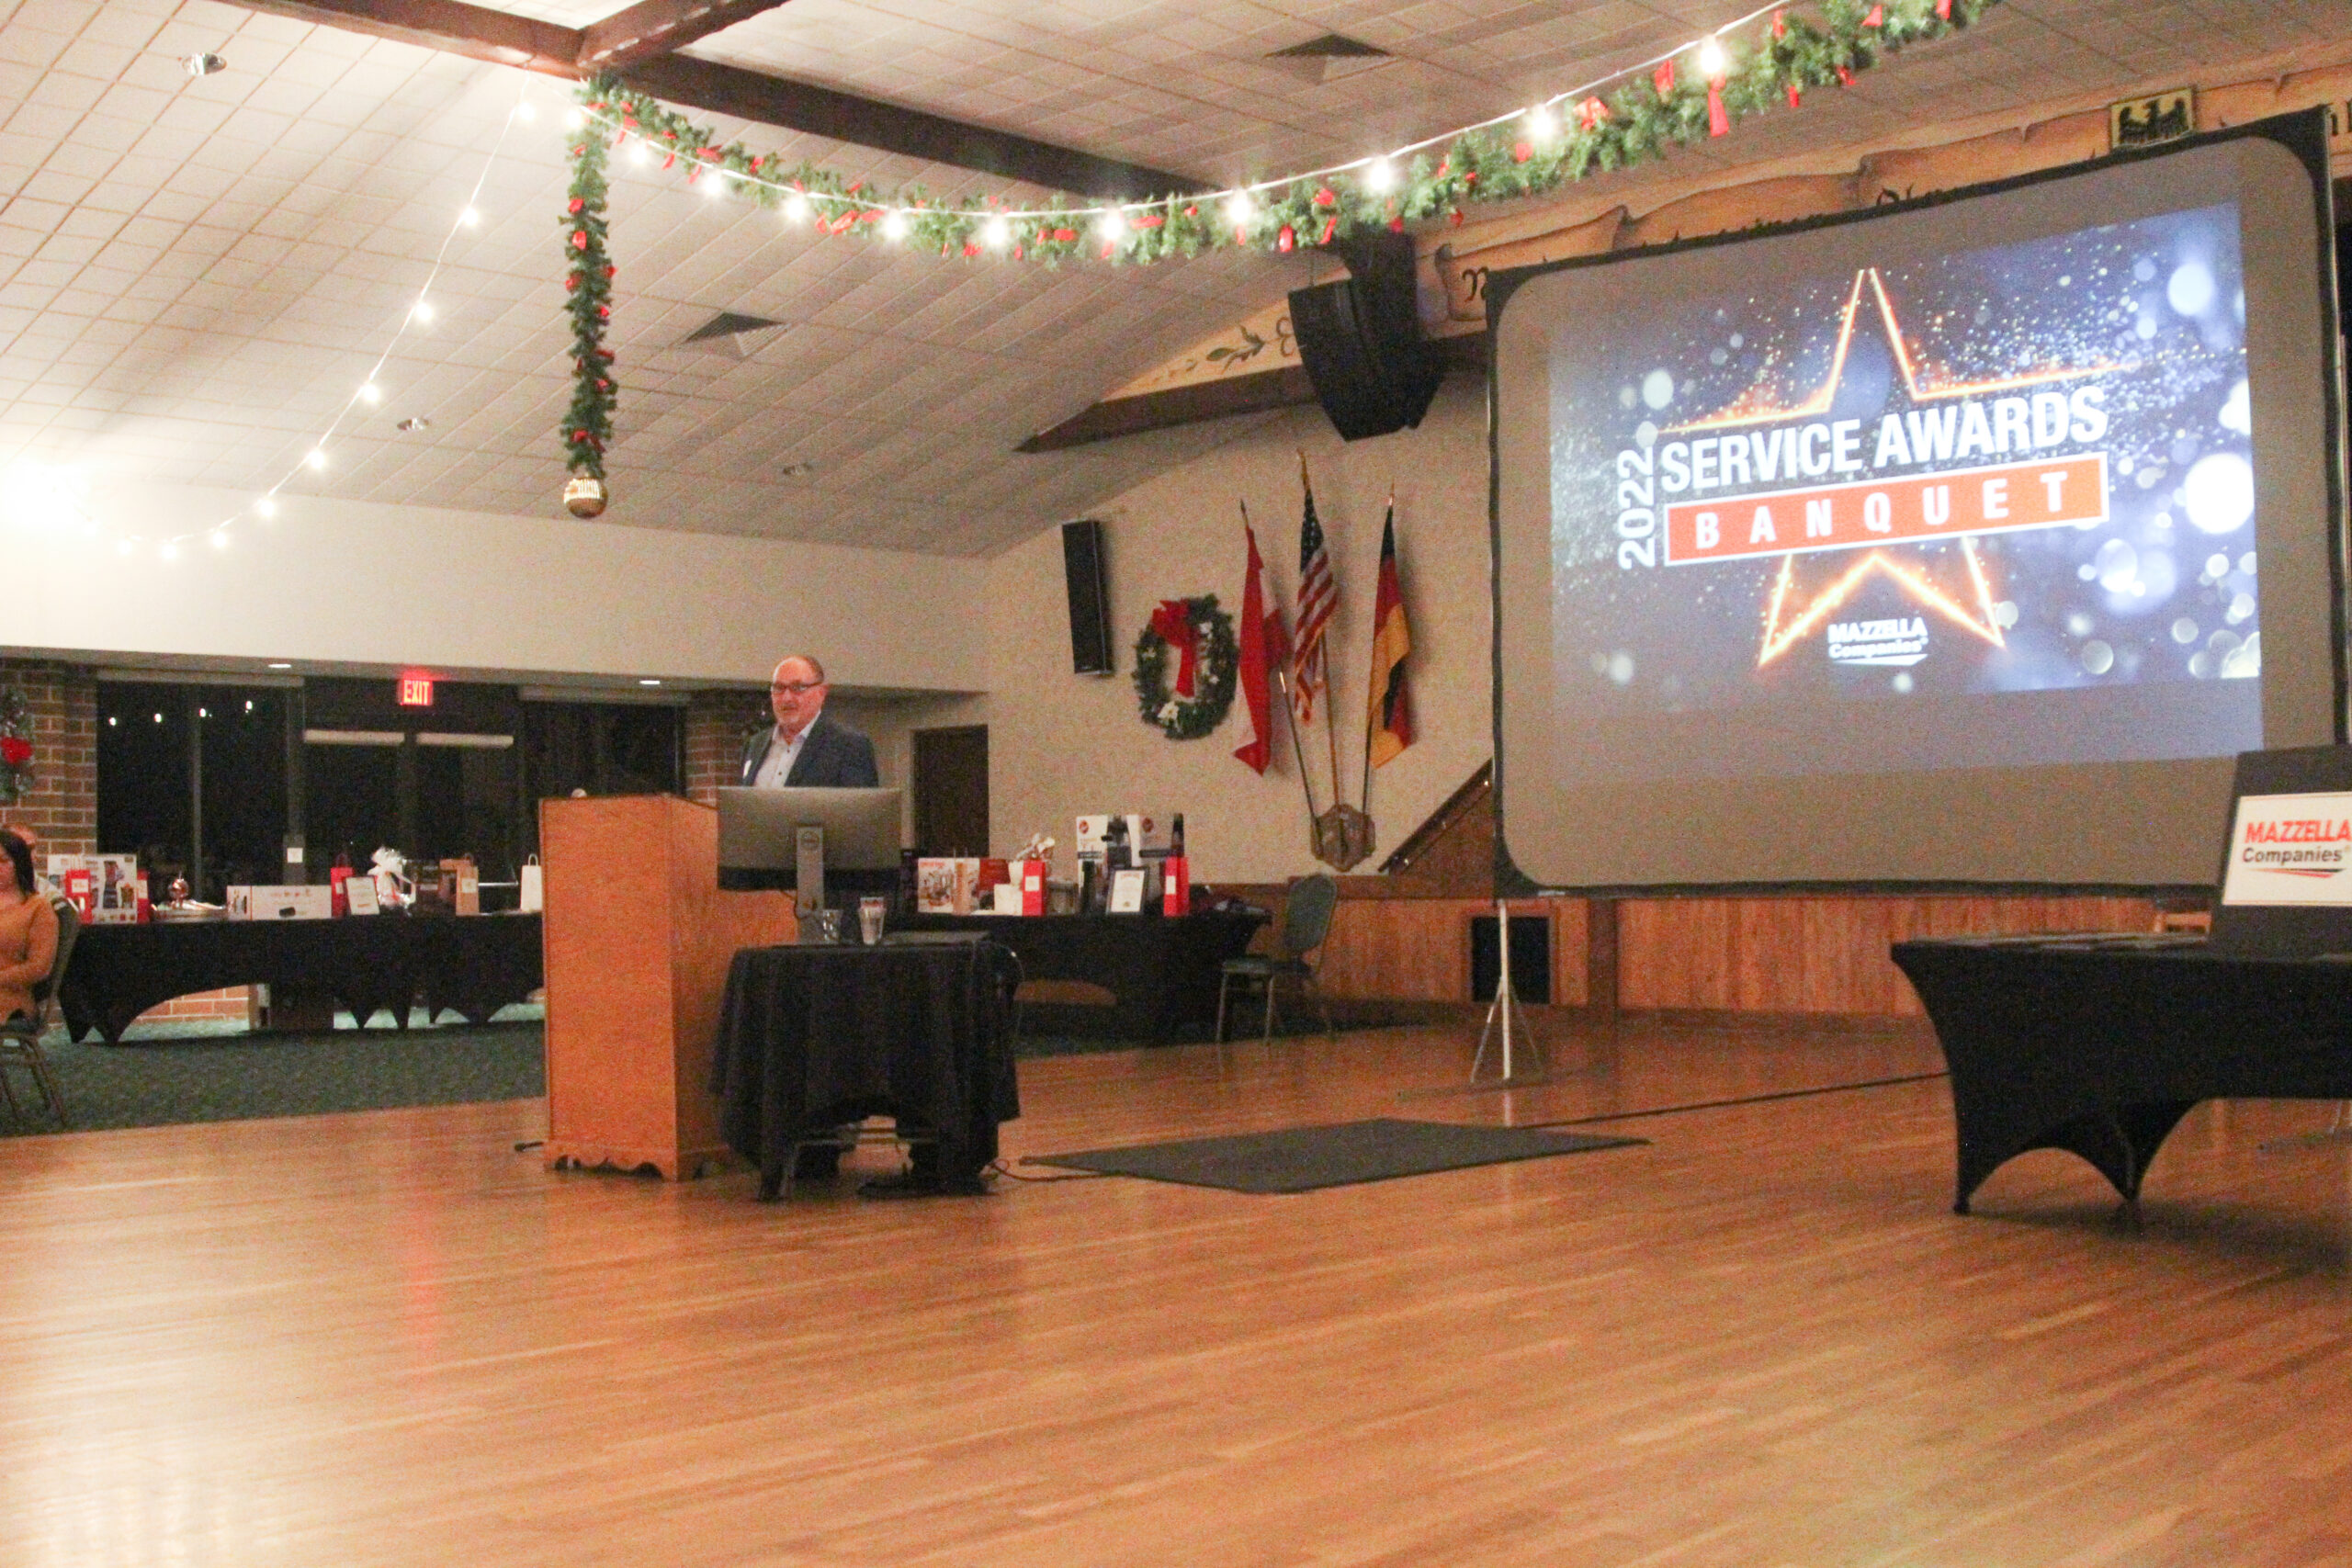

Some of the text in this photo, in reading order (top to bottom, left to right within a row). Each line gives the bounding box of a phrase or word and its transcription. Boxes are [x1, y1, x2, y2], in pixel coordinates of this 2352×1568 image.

[1660, 386, 2109, 492] SERVICE AWARDS
[1617, 446, 1655, 570] 2022
[1695, 471, 2068, 549] BANQUET
[1827, 616, 1928, 643] MAZZELLA
[404, 680, 430, 705] EXIT
[2245, 819, 2352, 843] MAZZELLA
[2242, 846, 2343, 865] Companies
